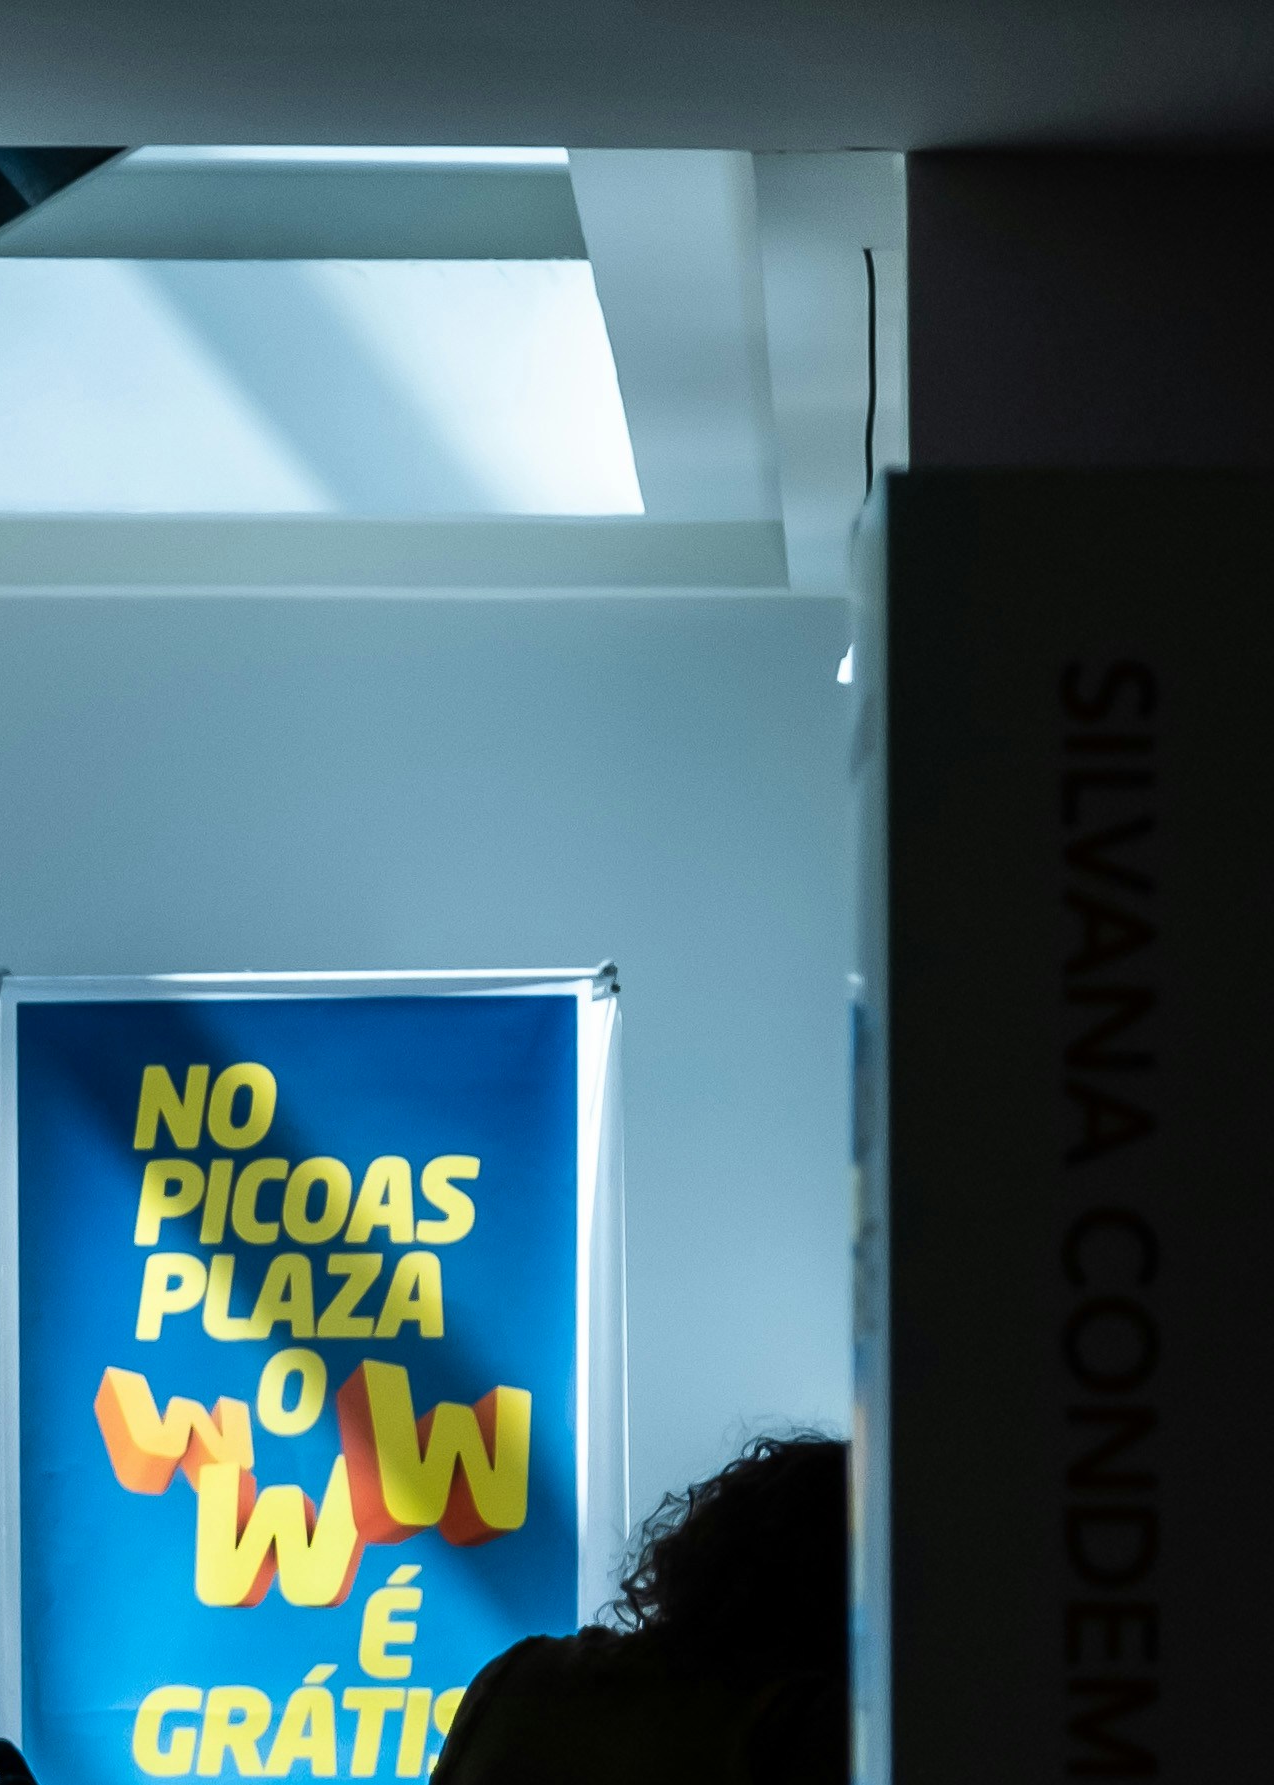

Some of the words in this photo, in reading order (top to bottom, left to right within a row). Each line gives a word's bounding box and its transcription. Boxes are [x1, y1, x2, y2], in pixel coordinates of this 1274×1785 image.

[1060, 660, 1155, 1168] SILVANA
[132, 1061, 278, 1152] NO
[133, 1155, 482, 1247] PICOAS
[133, 1250, 445, 1342] PLAZA
[256, 1346, 329, 1437] O
[358, 1563, 423, 1681] É
